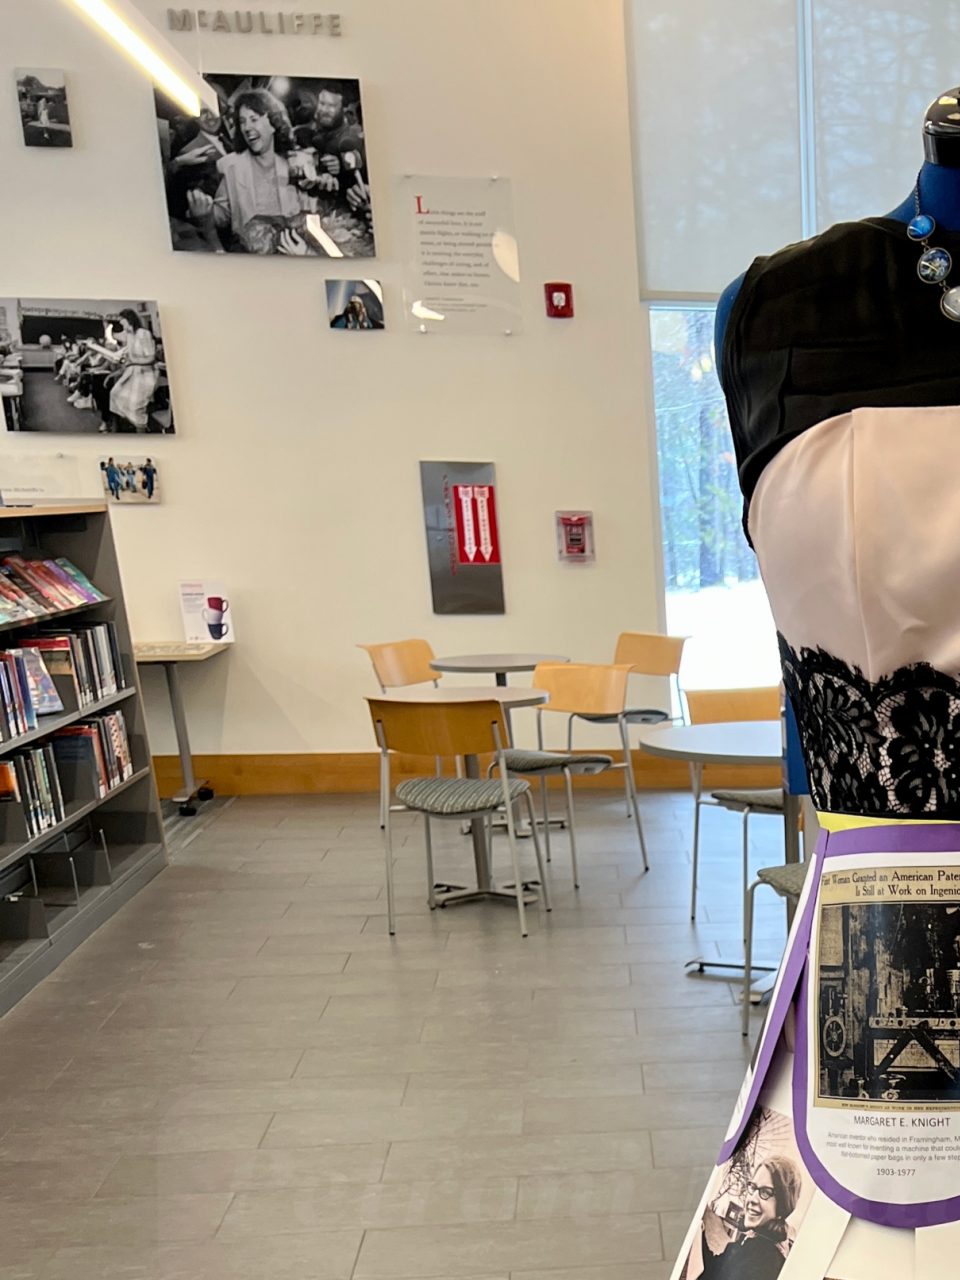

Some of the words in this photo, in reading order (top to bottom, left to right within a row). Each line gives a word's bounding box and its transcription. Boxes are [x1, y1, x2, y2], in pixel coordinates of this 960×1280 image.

[892, 871, 933, 881] American
[877, 887, 884, 895] at
[888, 885, 912, 895] Work
[916, 887, 927, 895] on
[854, 1115, 896, 1126] MARGARET
[900, 1118, 908, 1127] E.
[912, 1117, 951, 1127] KNIGHT
[877, 1168, 915, 1176] 1903-1977
